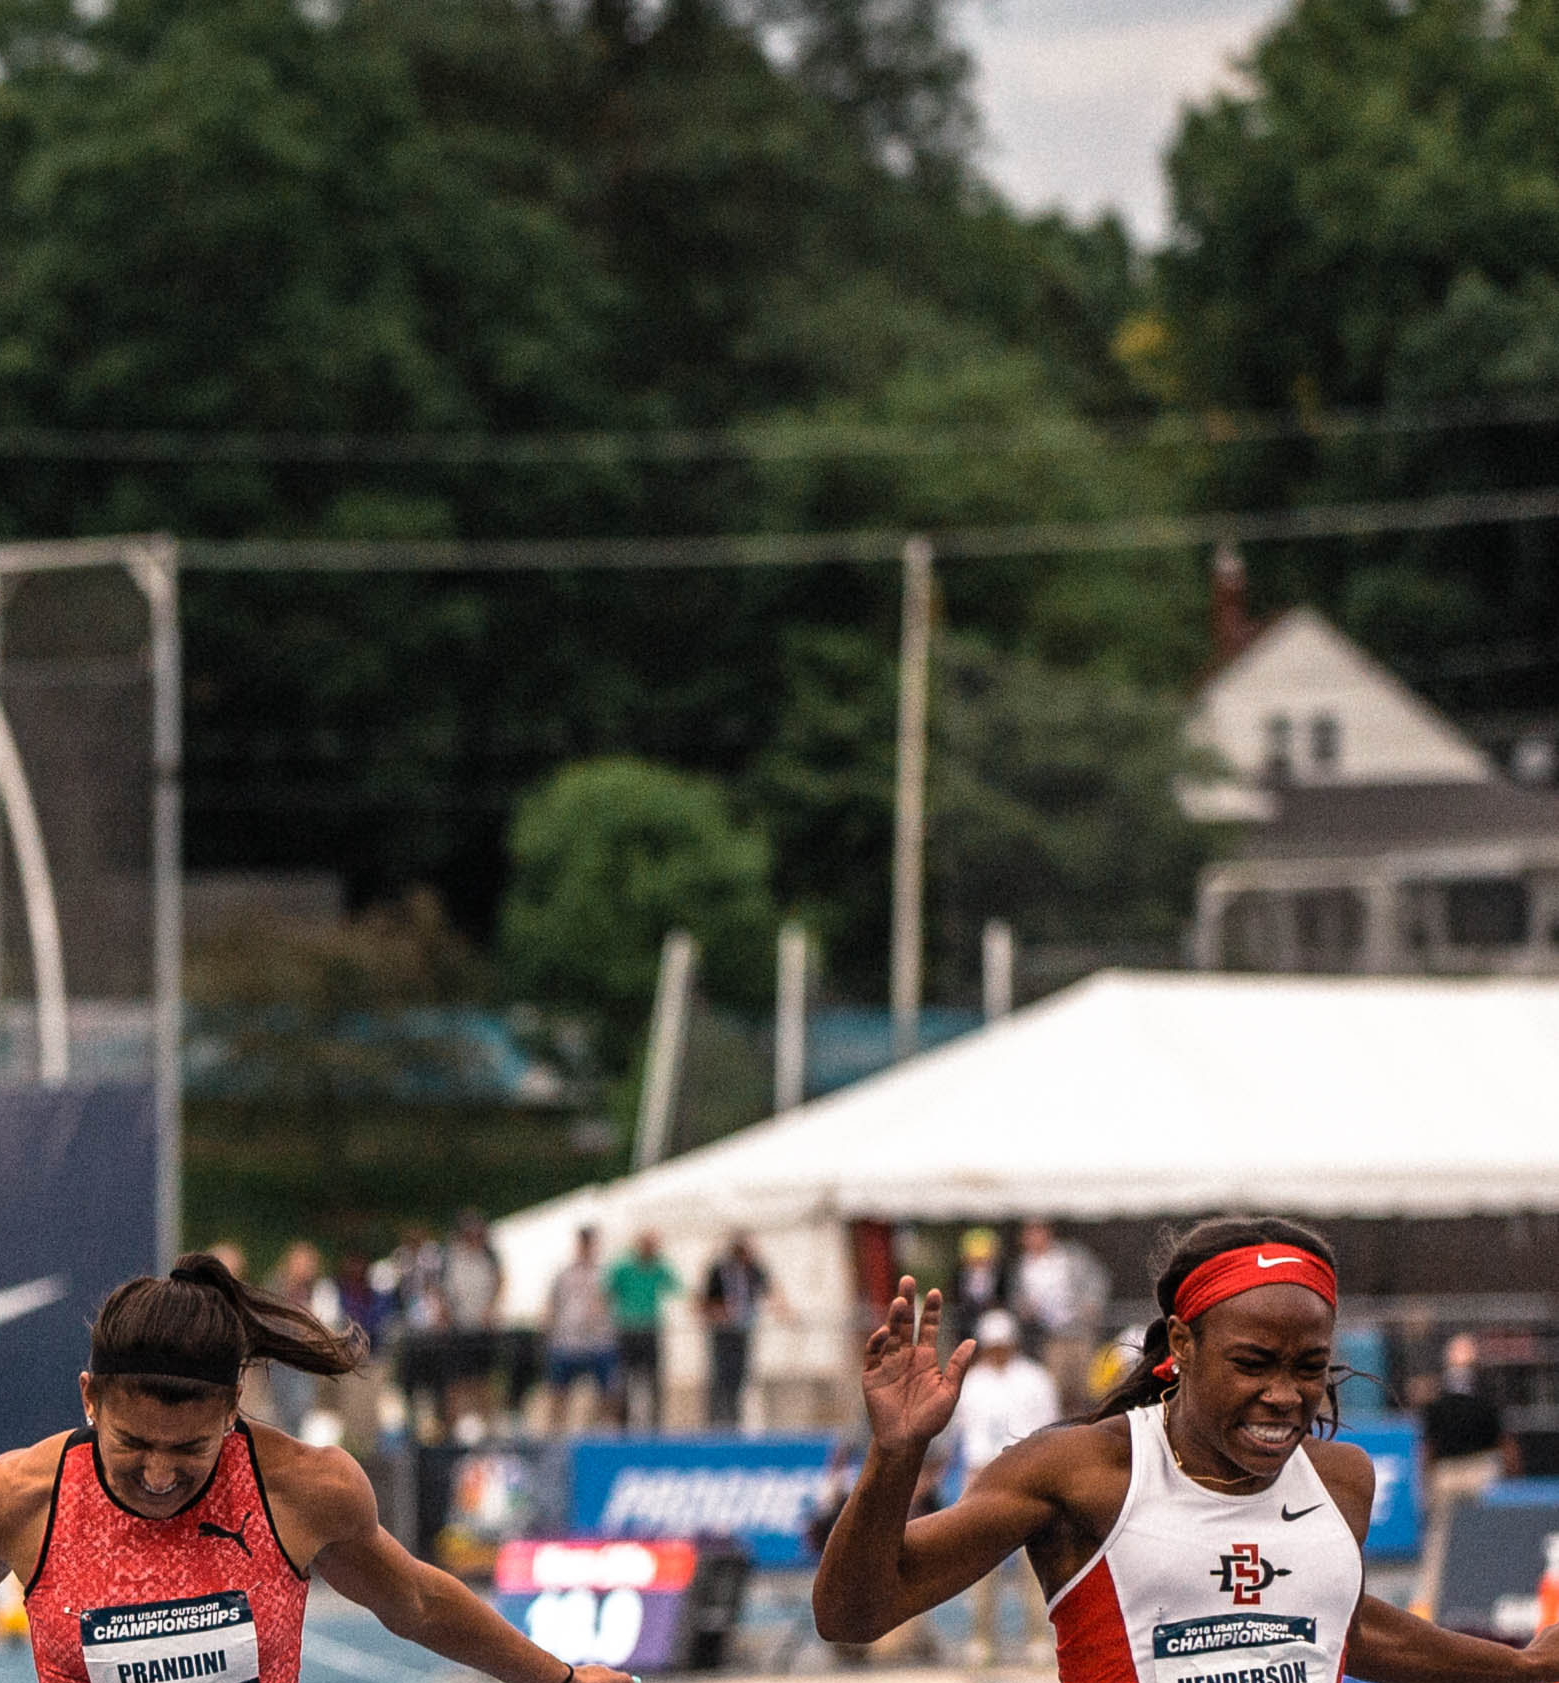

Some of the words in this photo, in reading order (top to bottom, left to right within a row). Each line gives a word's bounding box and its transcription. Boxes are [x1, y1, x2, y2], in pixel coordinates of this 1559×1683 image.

[93, 1607, 240, 1640] CHAMPIONSHIPS
[110, 1613, 134, 1624] 2018
[137, 1609, 168, 1621] USATF
[171, 1602, 220, 1617] OUTDOOR
[1185, 1626, 1210, 1636] 2018
